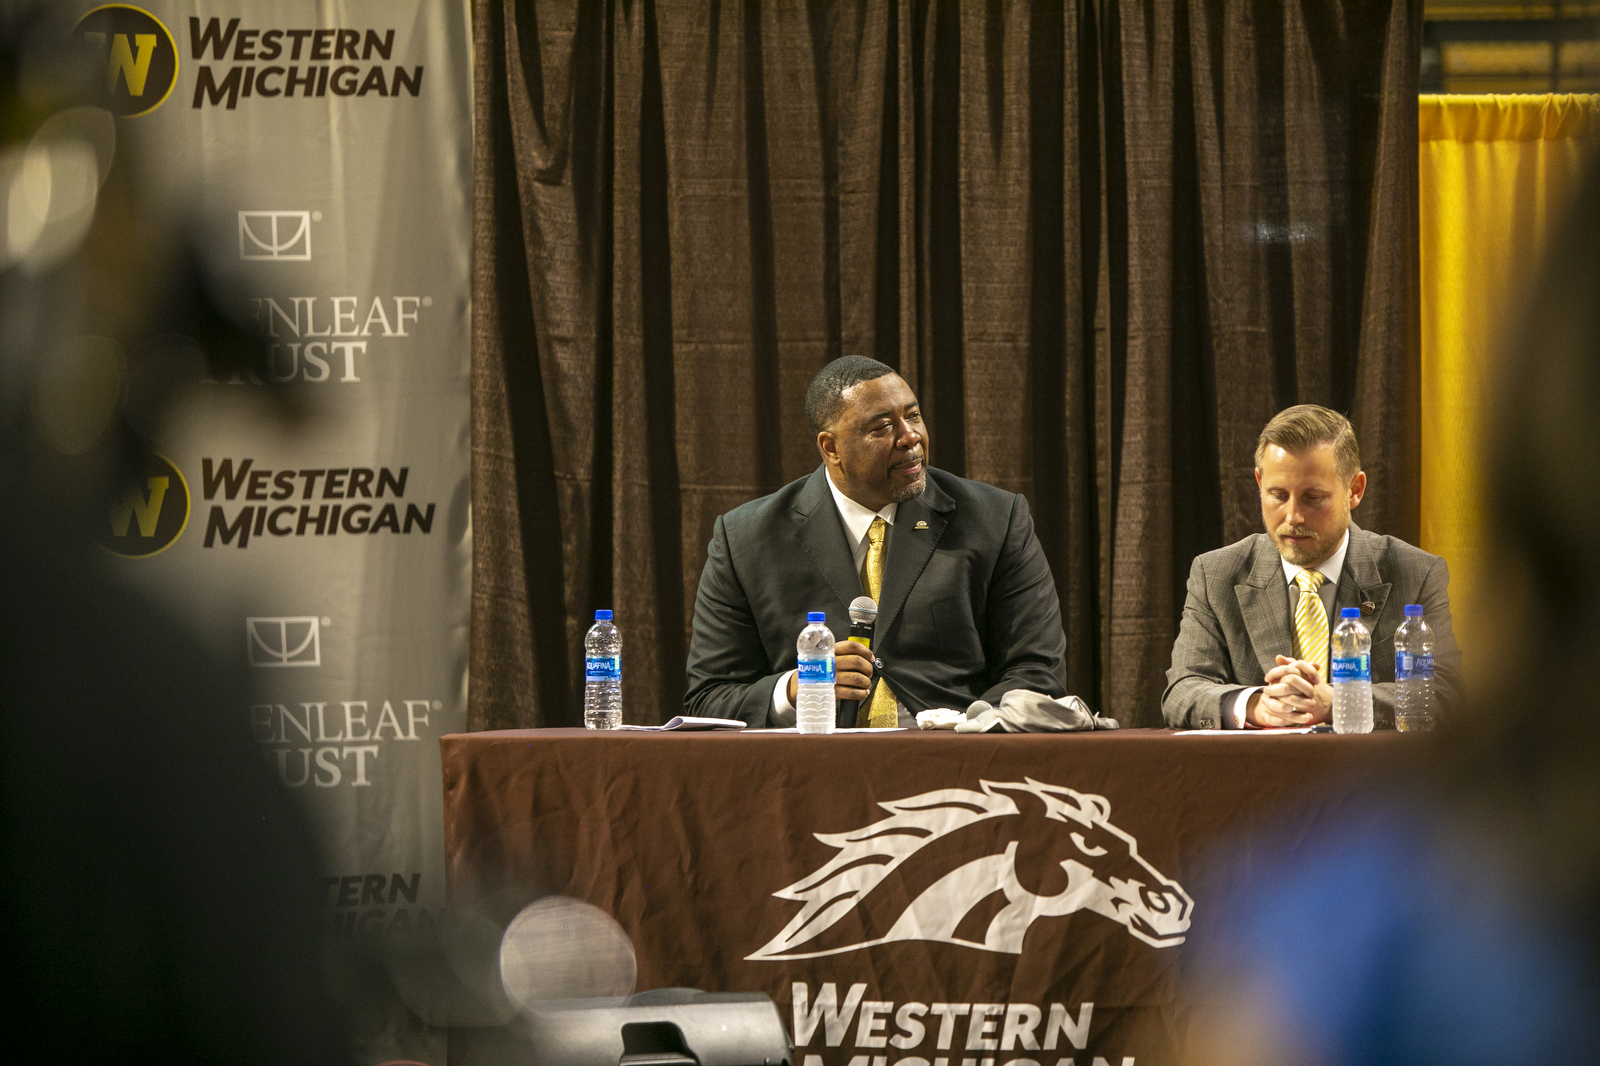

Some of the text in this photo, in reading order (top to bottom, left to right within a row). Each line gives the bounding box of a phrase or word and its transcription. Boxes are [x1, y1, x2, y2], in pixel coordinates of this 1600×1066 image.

[189, 16, 396, 61] WESTERN
[192, 65, 424, 110] MICHIGAN
[201, 457, 409, 501] WESTERN
[203, 502, 436, 548] MICHIGAN
[791, 981, 1094, 1051] WESTERN
